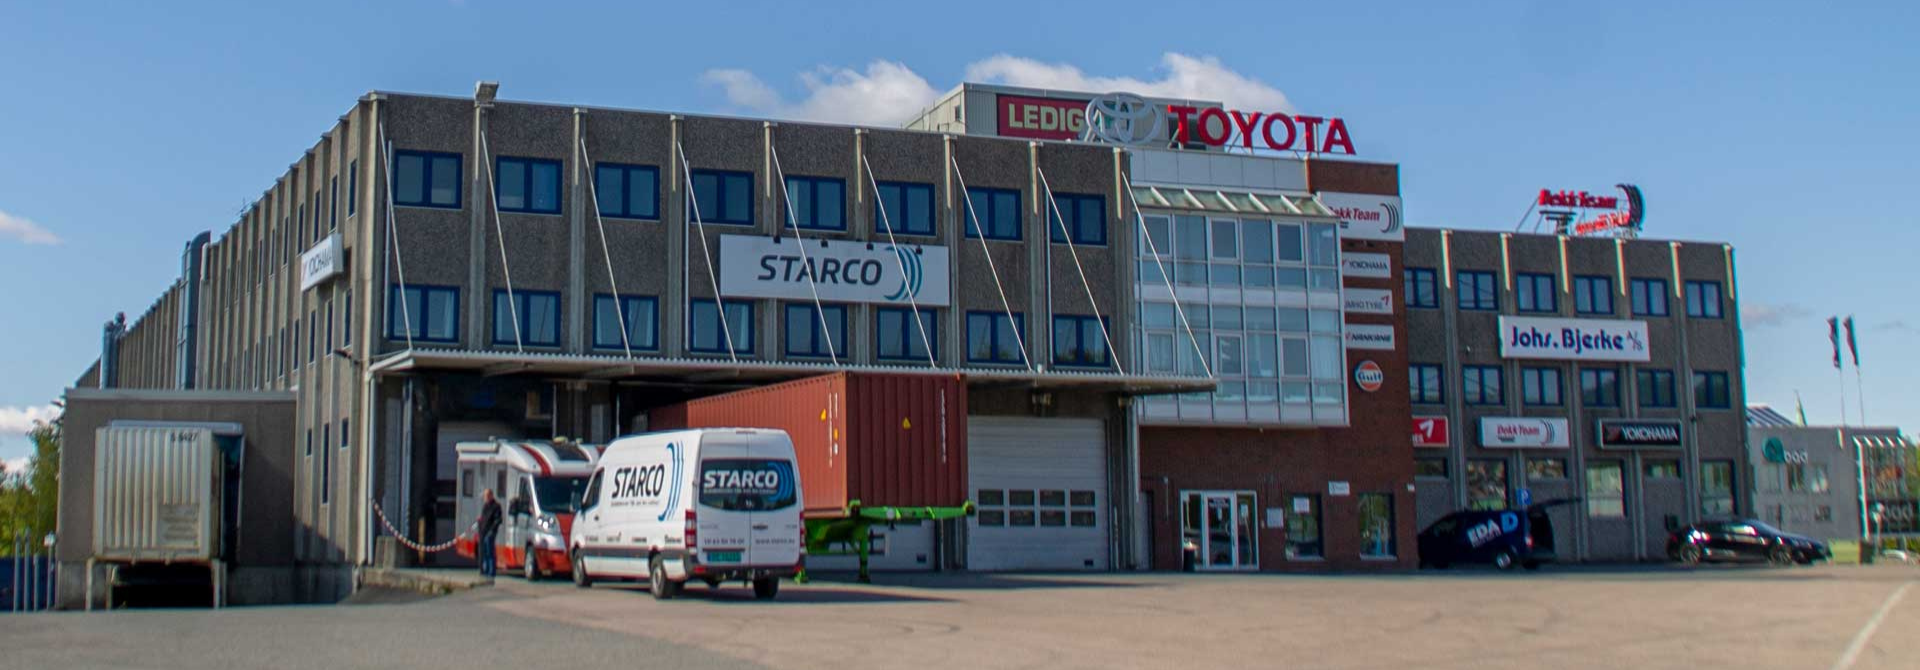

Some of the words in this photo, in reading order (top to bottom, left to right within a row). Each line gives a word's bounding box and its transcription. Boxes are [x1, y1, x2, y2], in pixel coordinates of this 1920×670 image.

[1008, 103, 1085, 132] LEDIG
[1168, 104, 1356, 155] TOYOTA
[757, 254, 883, 286] STARCO
[1512, 326, 1558, 347] Johs.
[1562, 328, 1623, 354] Bjerke
[611, 464, 665, 499] STARCO
[703, 470, 778, 488] STARCO
